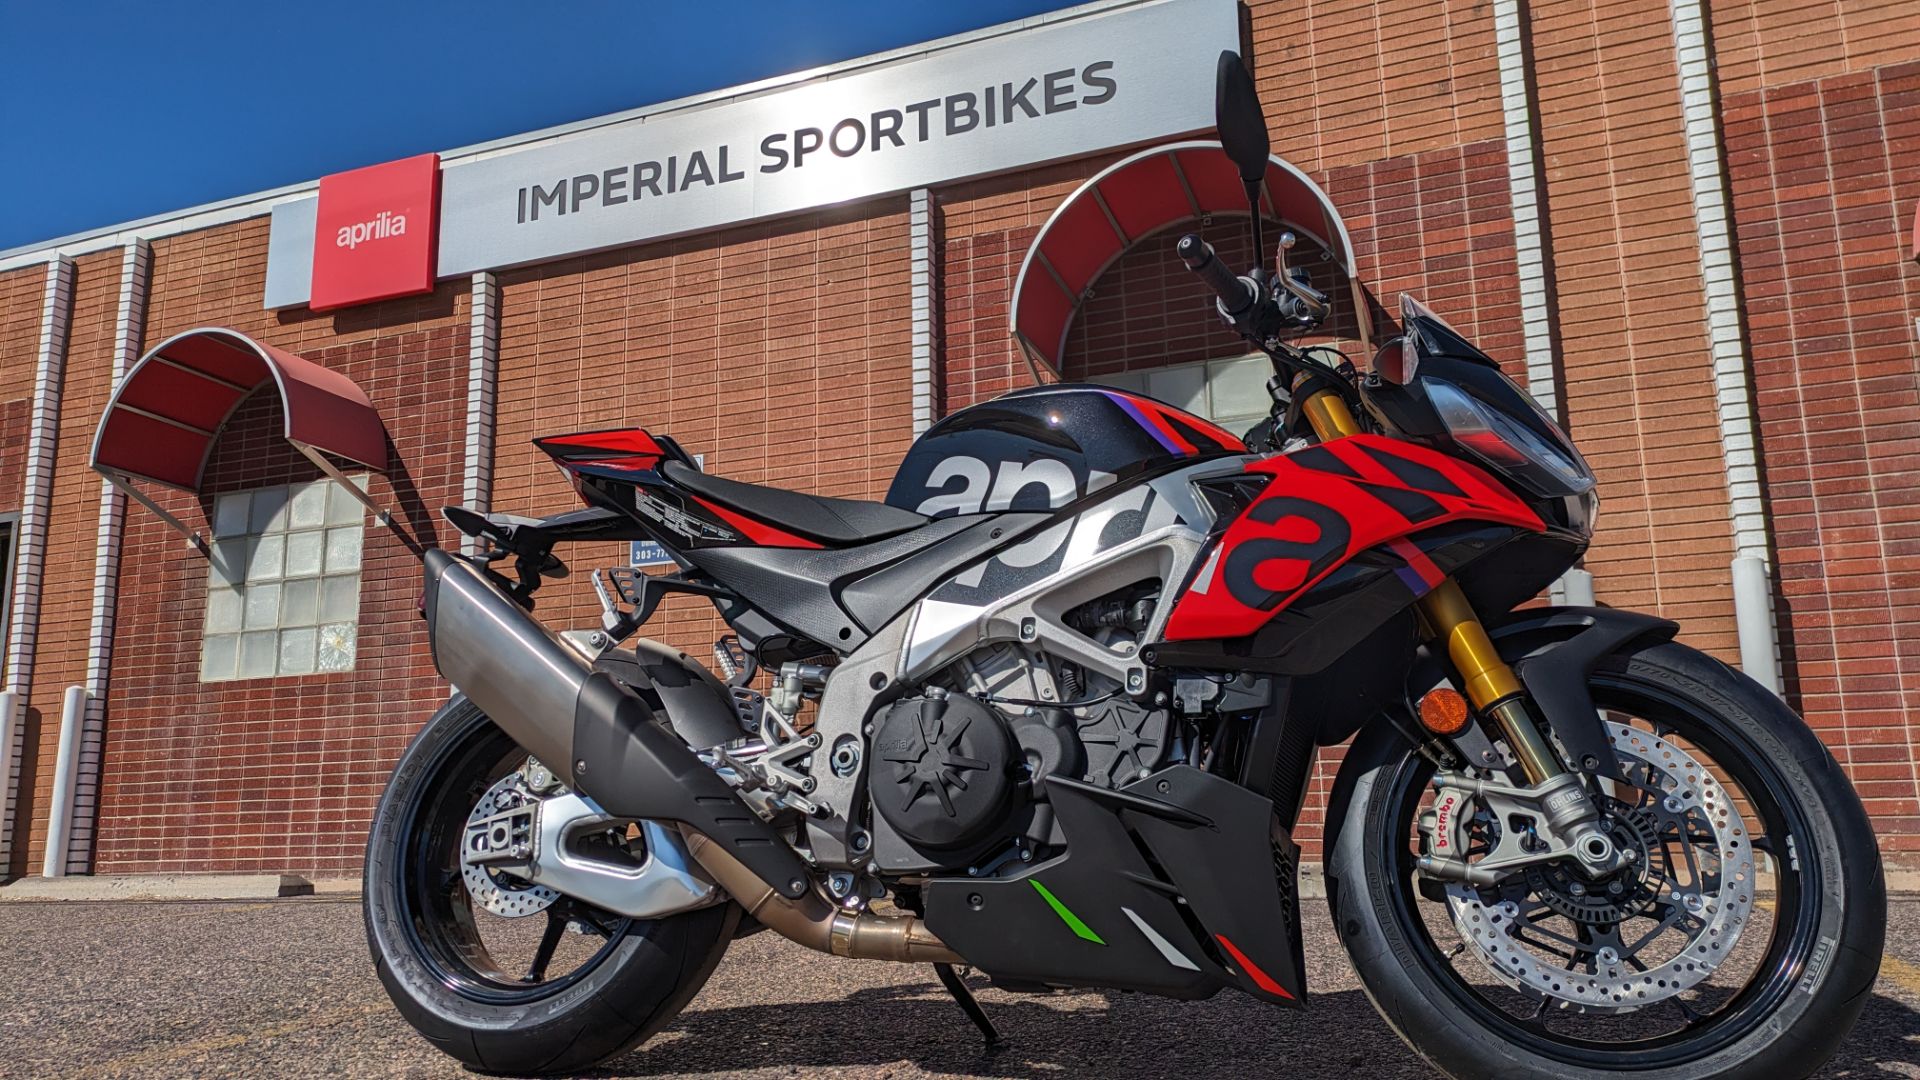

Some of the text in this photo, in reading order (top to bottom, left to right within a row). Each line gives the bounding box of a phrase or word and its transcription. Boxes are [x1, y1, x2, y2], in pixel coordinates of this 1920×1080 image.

[517, 60, 1117, 224] IMPERIAL SPORTBIKES
[336, 211, 406, 250] aprilia
[1436, 797, 1455, 848] brembo
[1800, 935, 1836, 995] PIRELLI
